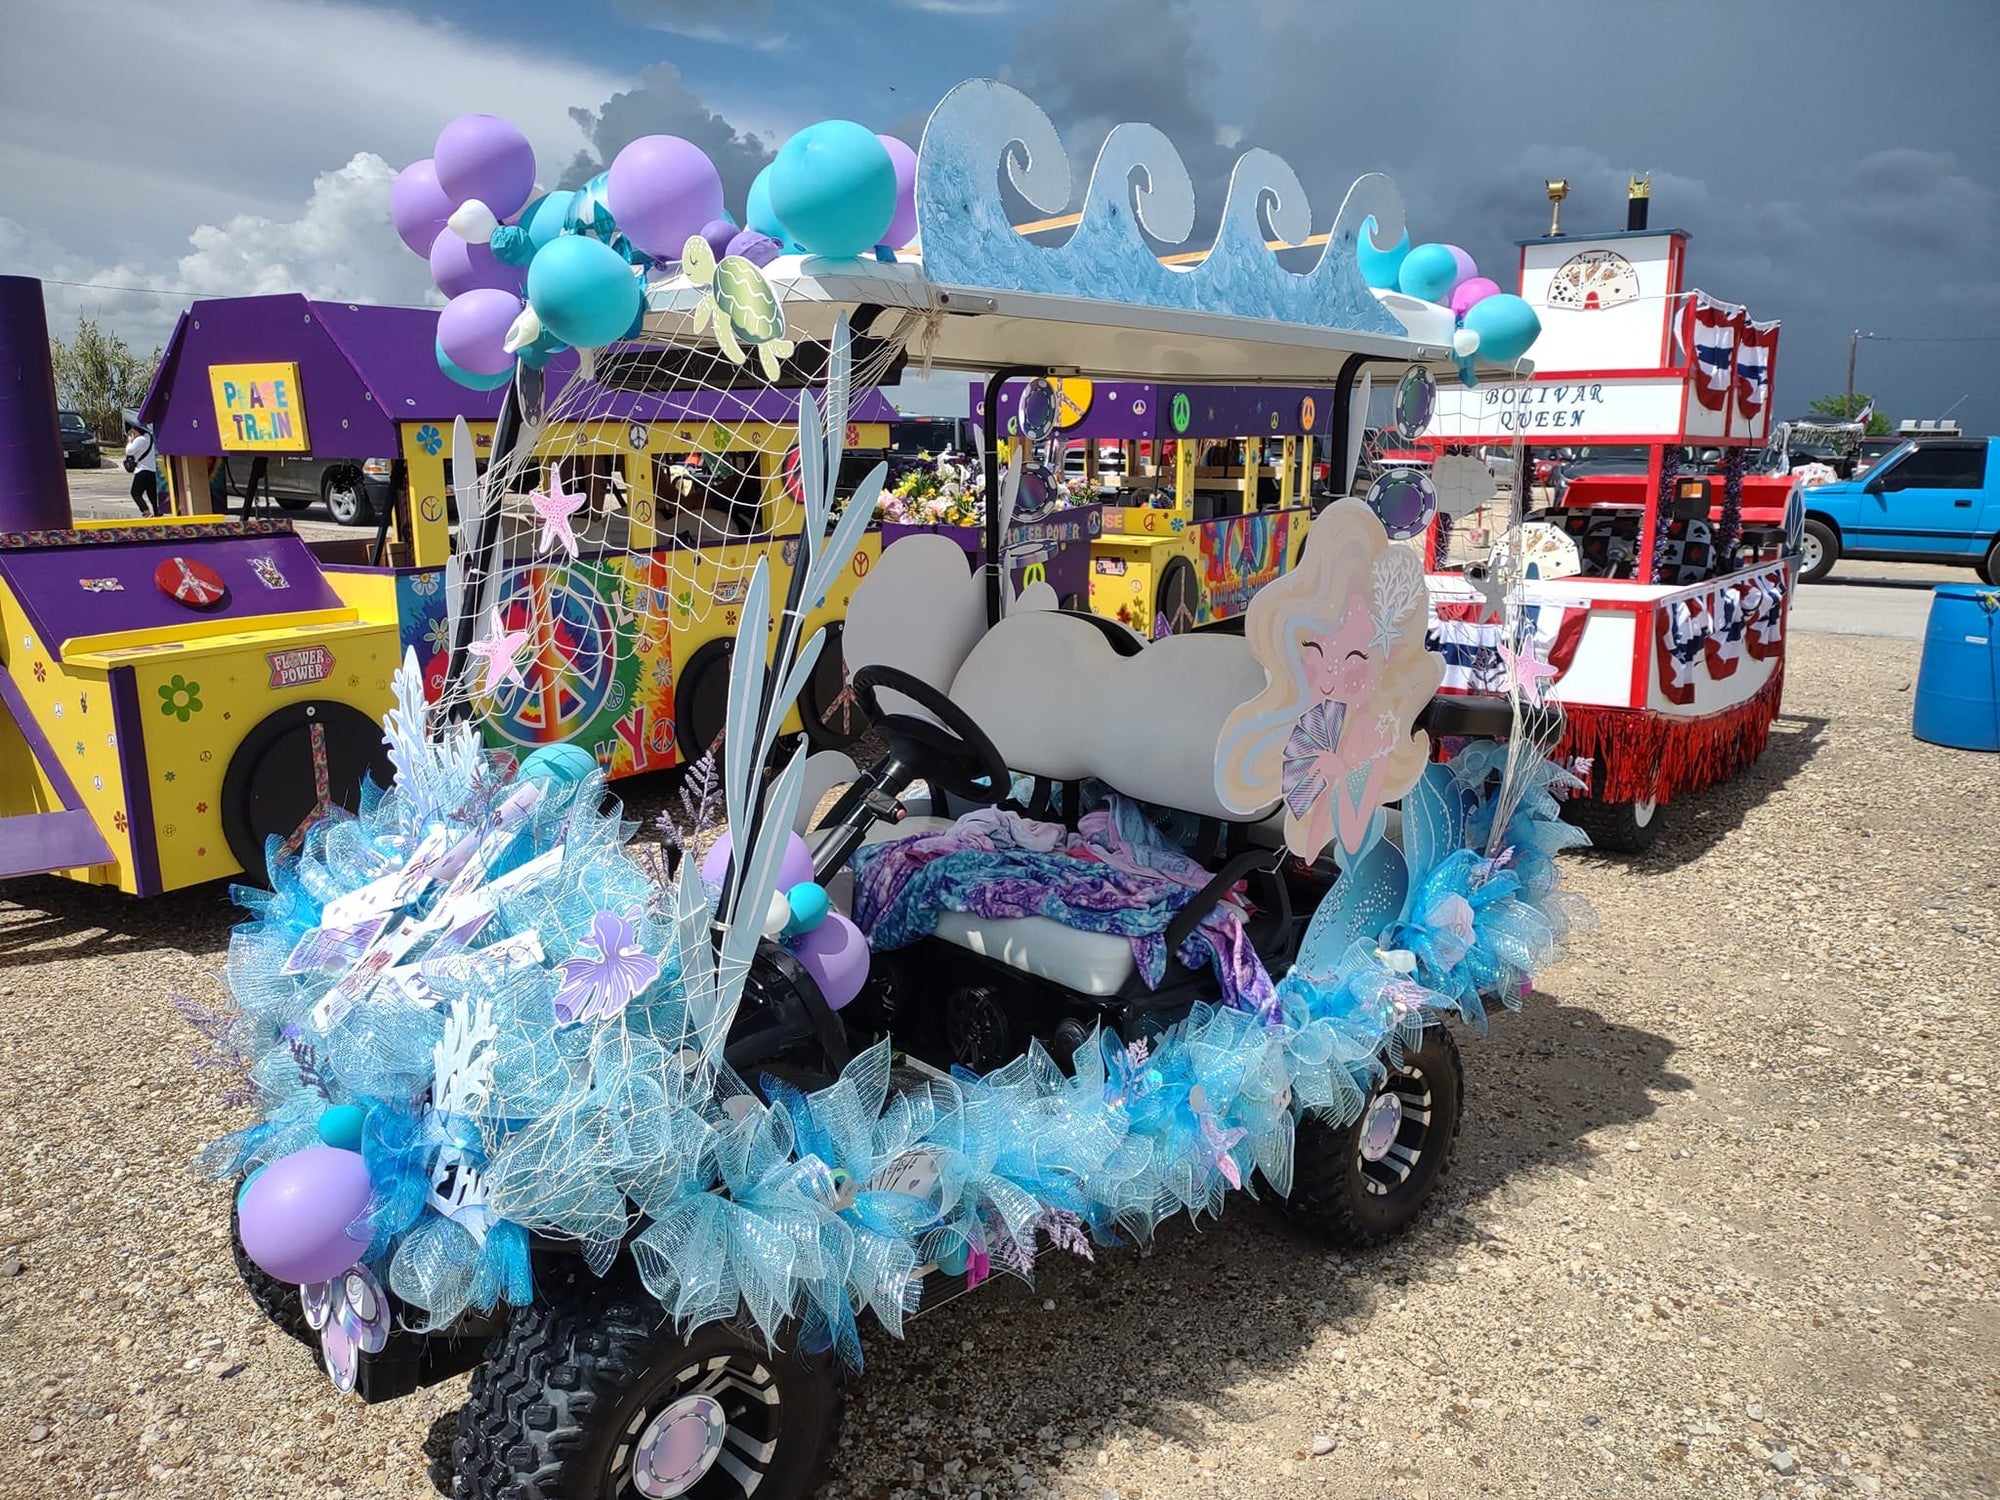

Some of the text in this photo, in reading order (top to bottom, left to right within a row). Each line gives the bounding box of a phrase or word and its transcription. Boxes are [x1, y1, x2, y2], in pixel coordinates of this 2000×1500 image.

[223, 380, 289, 409] PEACE
[1485, 384, 1604, 405] BOLIVAR
[232, 411, 294, 441] TRAIN
[1500, 410, 1585, 431] QUEEN
[274, 649, 324, 671] FLOWER
[281, 663, 324, 684] POWER
